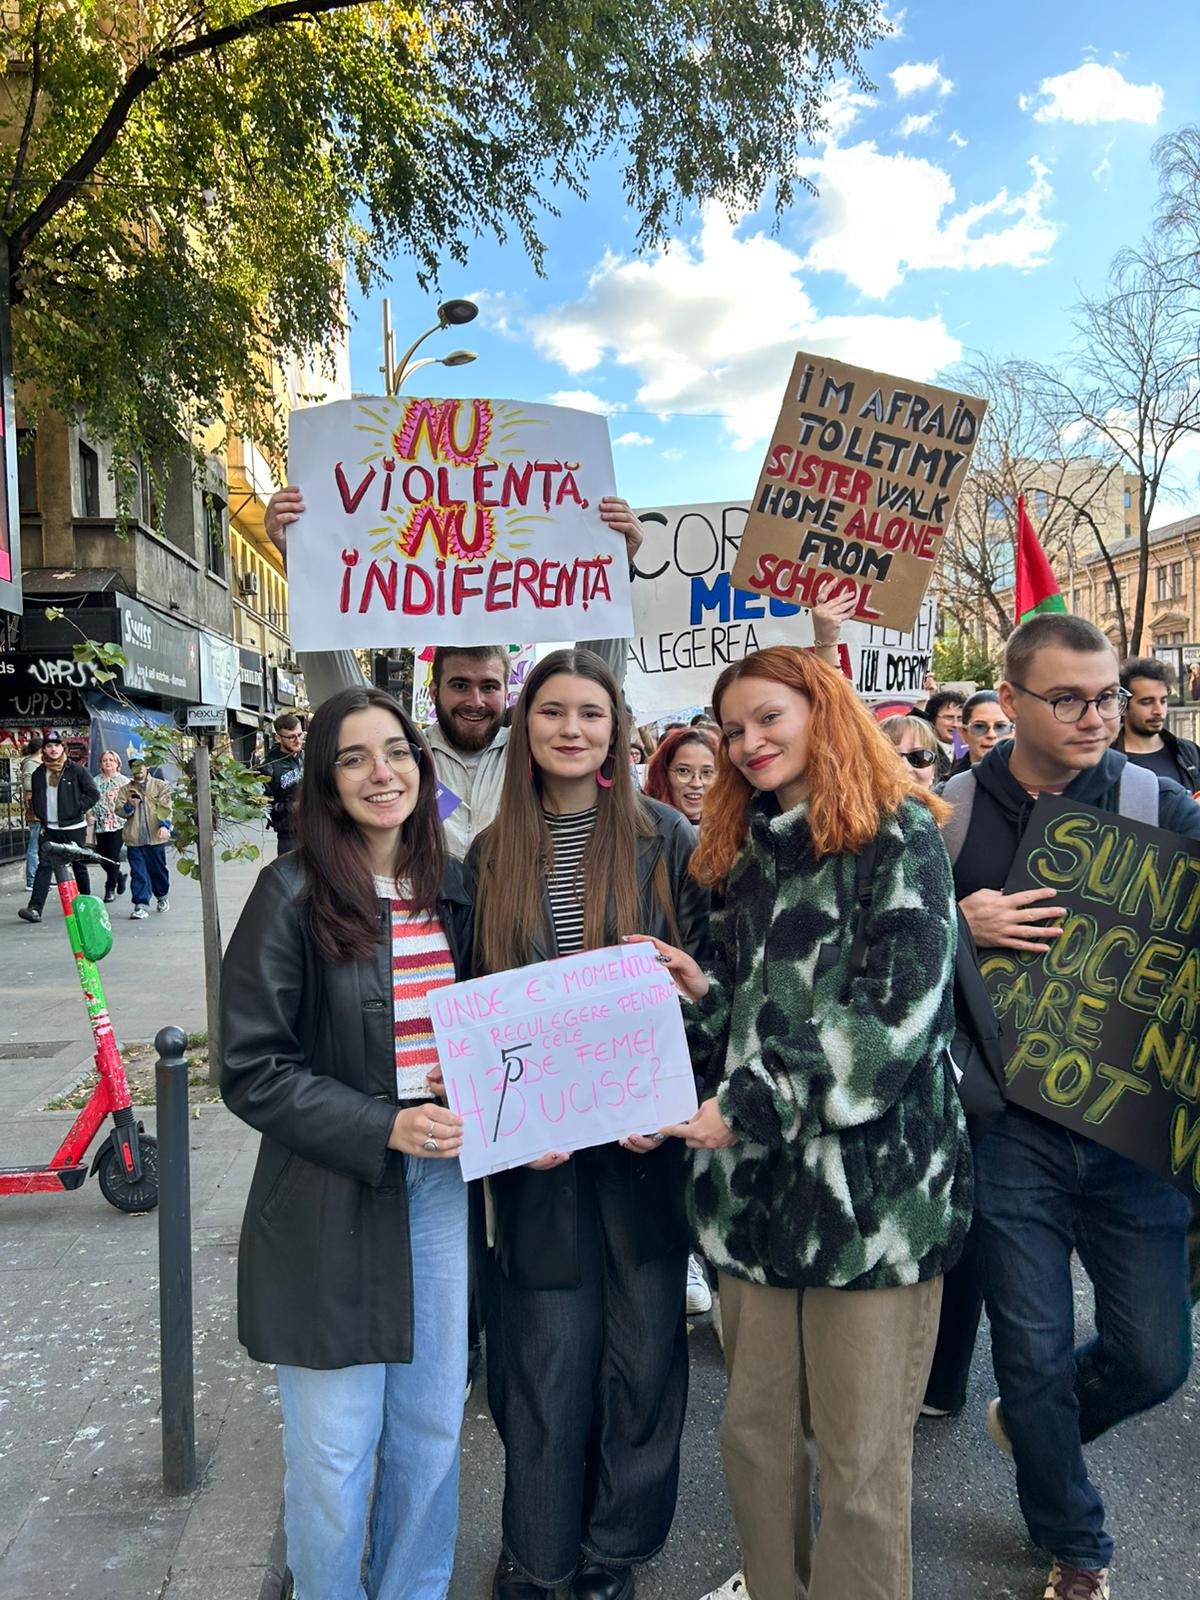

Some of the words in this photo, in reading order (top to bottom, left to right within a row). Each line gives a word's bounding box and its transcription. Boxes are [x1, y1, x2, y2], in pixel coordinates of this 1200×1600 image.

[402, 399, 487, 463] NU
[860, 388, 978, 445] AFRAID
[766, 445, 873, 506] SISTER
[877, 477, 950, 522] WALK
[907, 442, 968, 488] MY
[402, 503, 490, 559] NU
[636, 507, 750, 579] COR
[757, 484, 845, 532] HOME
[843, 508, 943, 561] ALONE
[800, 530, 895, 581] FROM
[125, 610, 151, 645] Swiss
[1018, 907, 1200, 1030] OCEA
[435, 988, 508, 1029] UNDE
[526, 979, 546, 1002] E
[447, 1037, 474, 1059] DE
[490, 1006, 610, 1046] RECULEGERE
[523, 1055, 560, 1088] DE
[576, 1027, 656, 1065] FEMEI
[542, 1028, 583, 1049] CELE
[540, 1057, 661, 1124] UCISE?
[1004, 1030, 1151, 1125] POT
